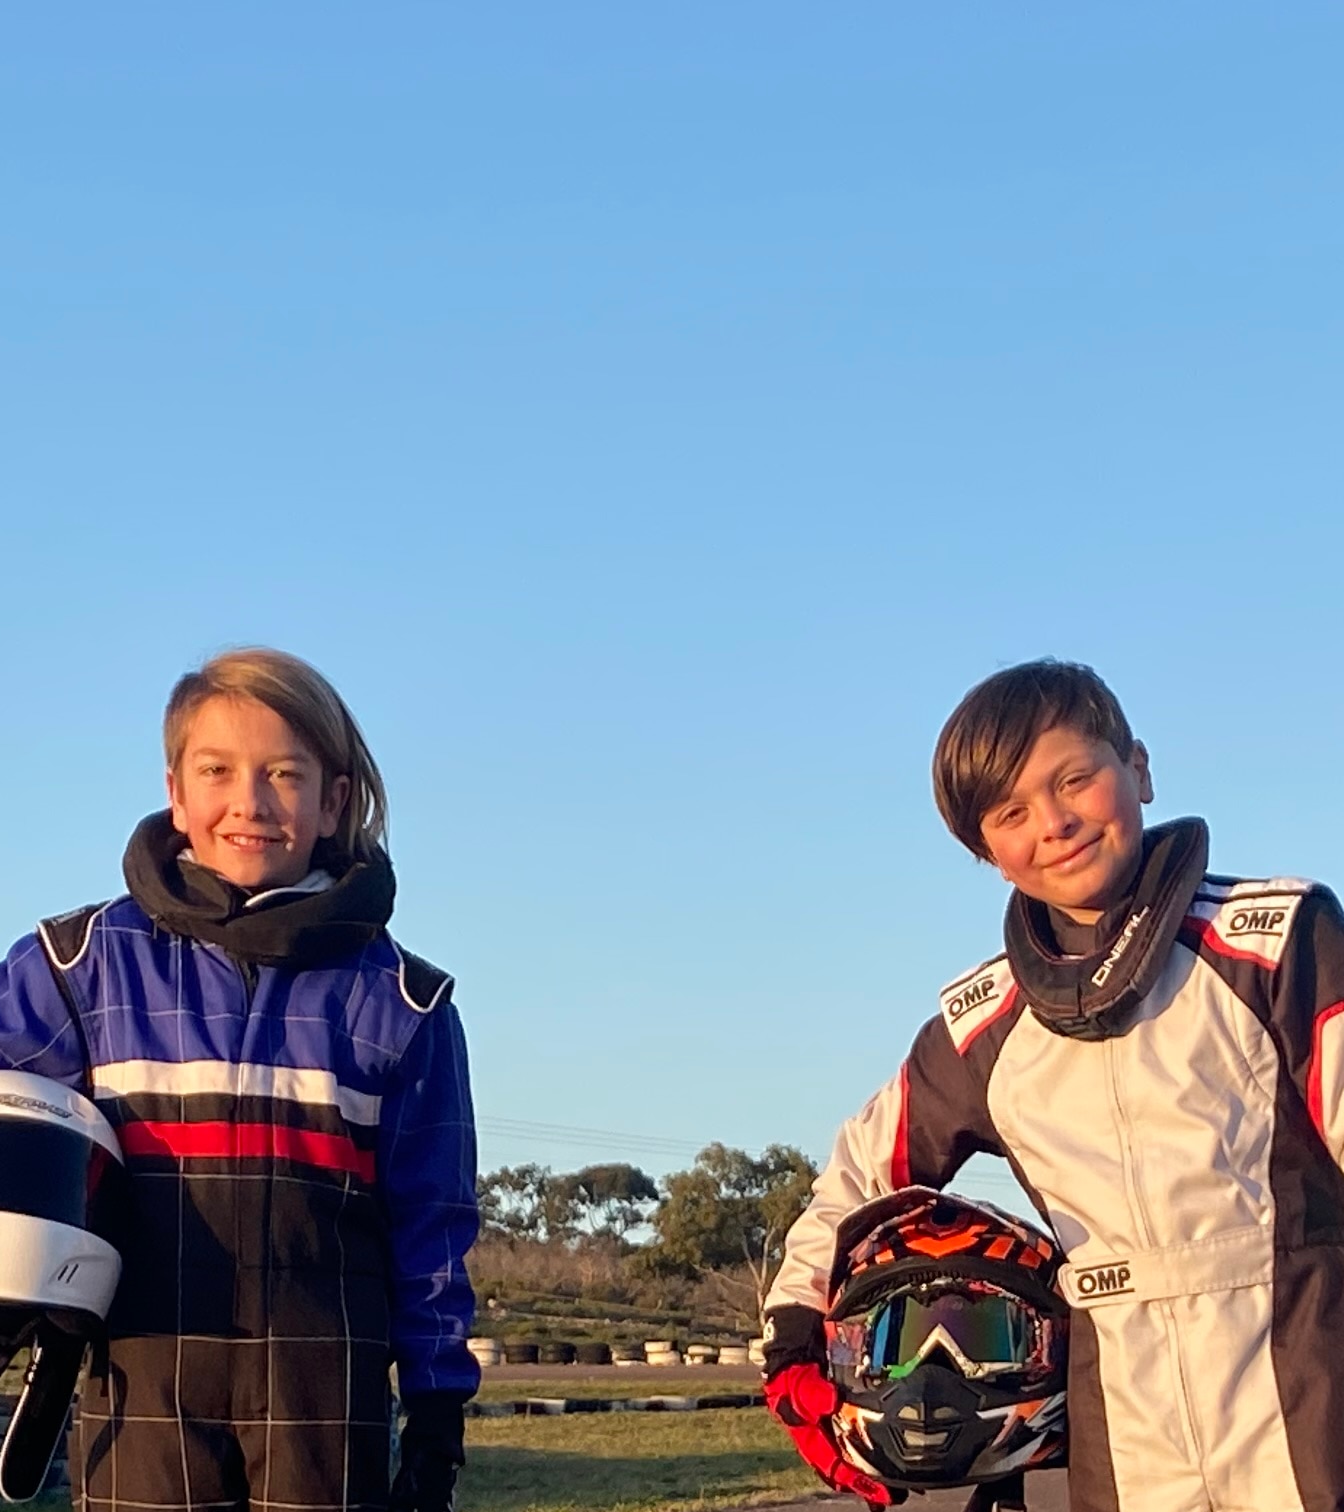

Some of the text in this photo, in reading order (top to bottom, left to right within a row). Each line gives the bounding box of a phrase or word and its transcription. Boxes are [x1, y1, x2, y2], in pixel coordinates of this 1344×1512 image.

[1229, 910, 1285, 931] OMP
[948, 978, 995, 1017] OMP
[1077, 1266, 1131, 1294] OMP
